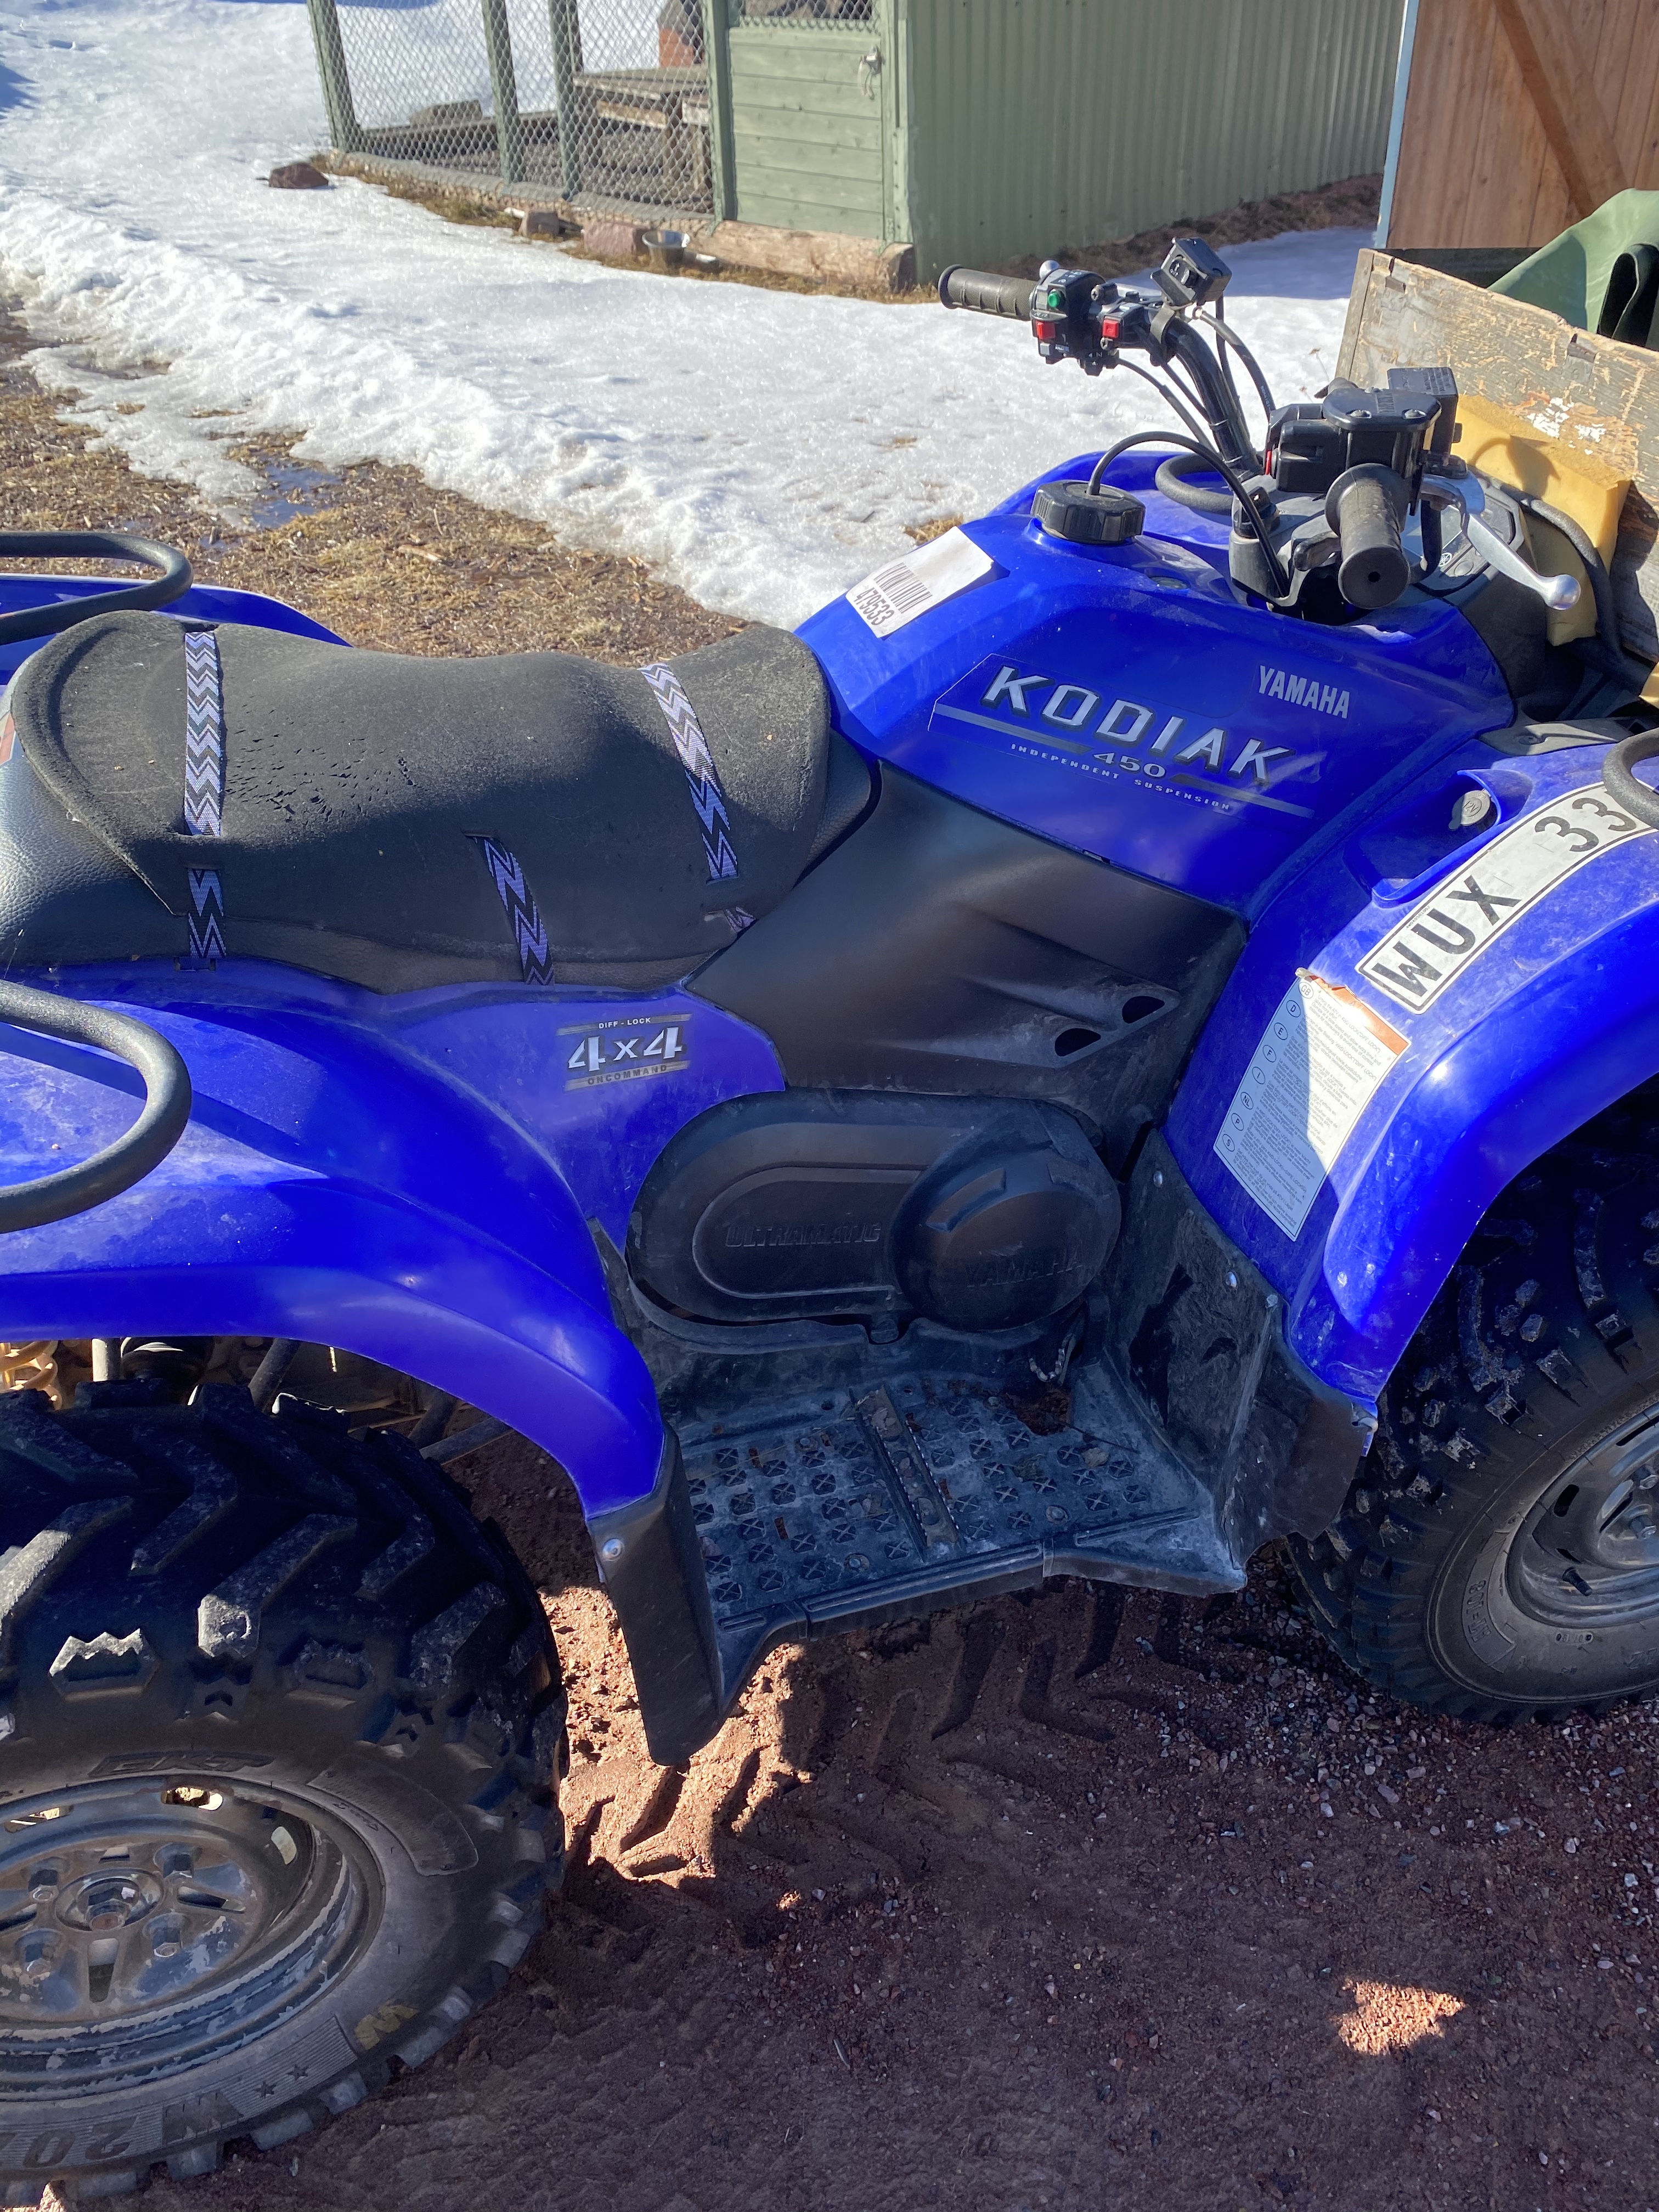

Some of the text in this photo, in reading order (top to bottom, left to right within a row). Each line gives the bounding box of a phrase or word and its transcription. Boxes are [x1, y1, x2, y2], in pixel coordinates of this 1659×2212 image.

[853, 588, 894, 626] 479533
[1257, 664, 1351, 719] YAMAHA
[982, 664, 1295, 782] KODIAK
[1093, 751, 1166, 778] 450
[1011, 743, 1231, 811] INDEPENDENT SUSPENSION
[1371, 791, 1637, 997] WUX 33
[1300, 984, 1311, 996] GB
[1290, 1003, 1296, 1013] D
[598, 1020, 618, 1029] DIFF
[627, 1017, 651, 1026] LOCK
[1277, 1026, 1284, 1036] E
[568, 1026, 682, 1071] 4x4
[1266, 1049, 1272, 1057] F
[588, 1064, 667, 1085] ONCOMMAND
[1242, 1094, 1251, 1107] NL
[1235, 1118, 1240, 1126] P
[1226, 1138, 1231, 1147] S
